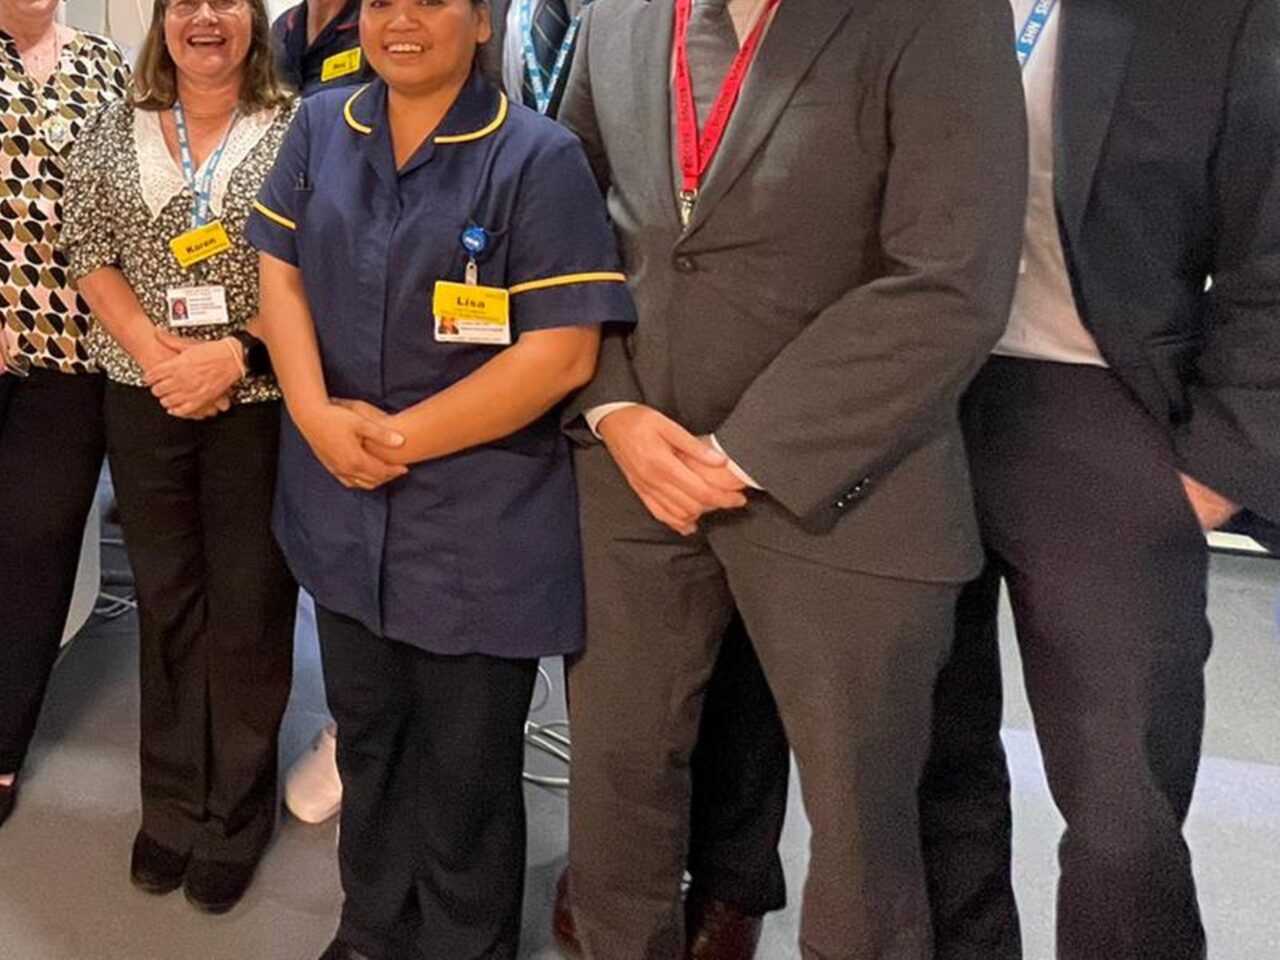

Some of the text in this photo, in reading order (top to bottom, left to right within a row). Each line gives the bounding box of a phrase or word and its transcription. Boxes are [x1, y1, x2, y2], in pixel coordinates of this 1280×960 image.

[1020, 20, 1042, 45] NHS
[185, 238, 217, 254] Karen
[456, 296, 486, 309] Lisa
